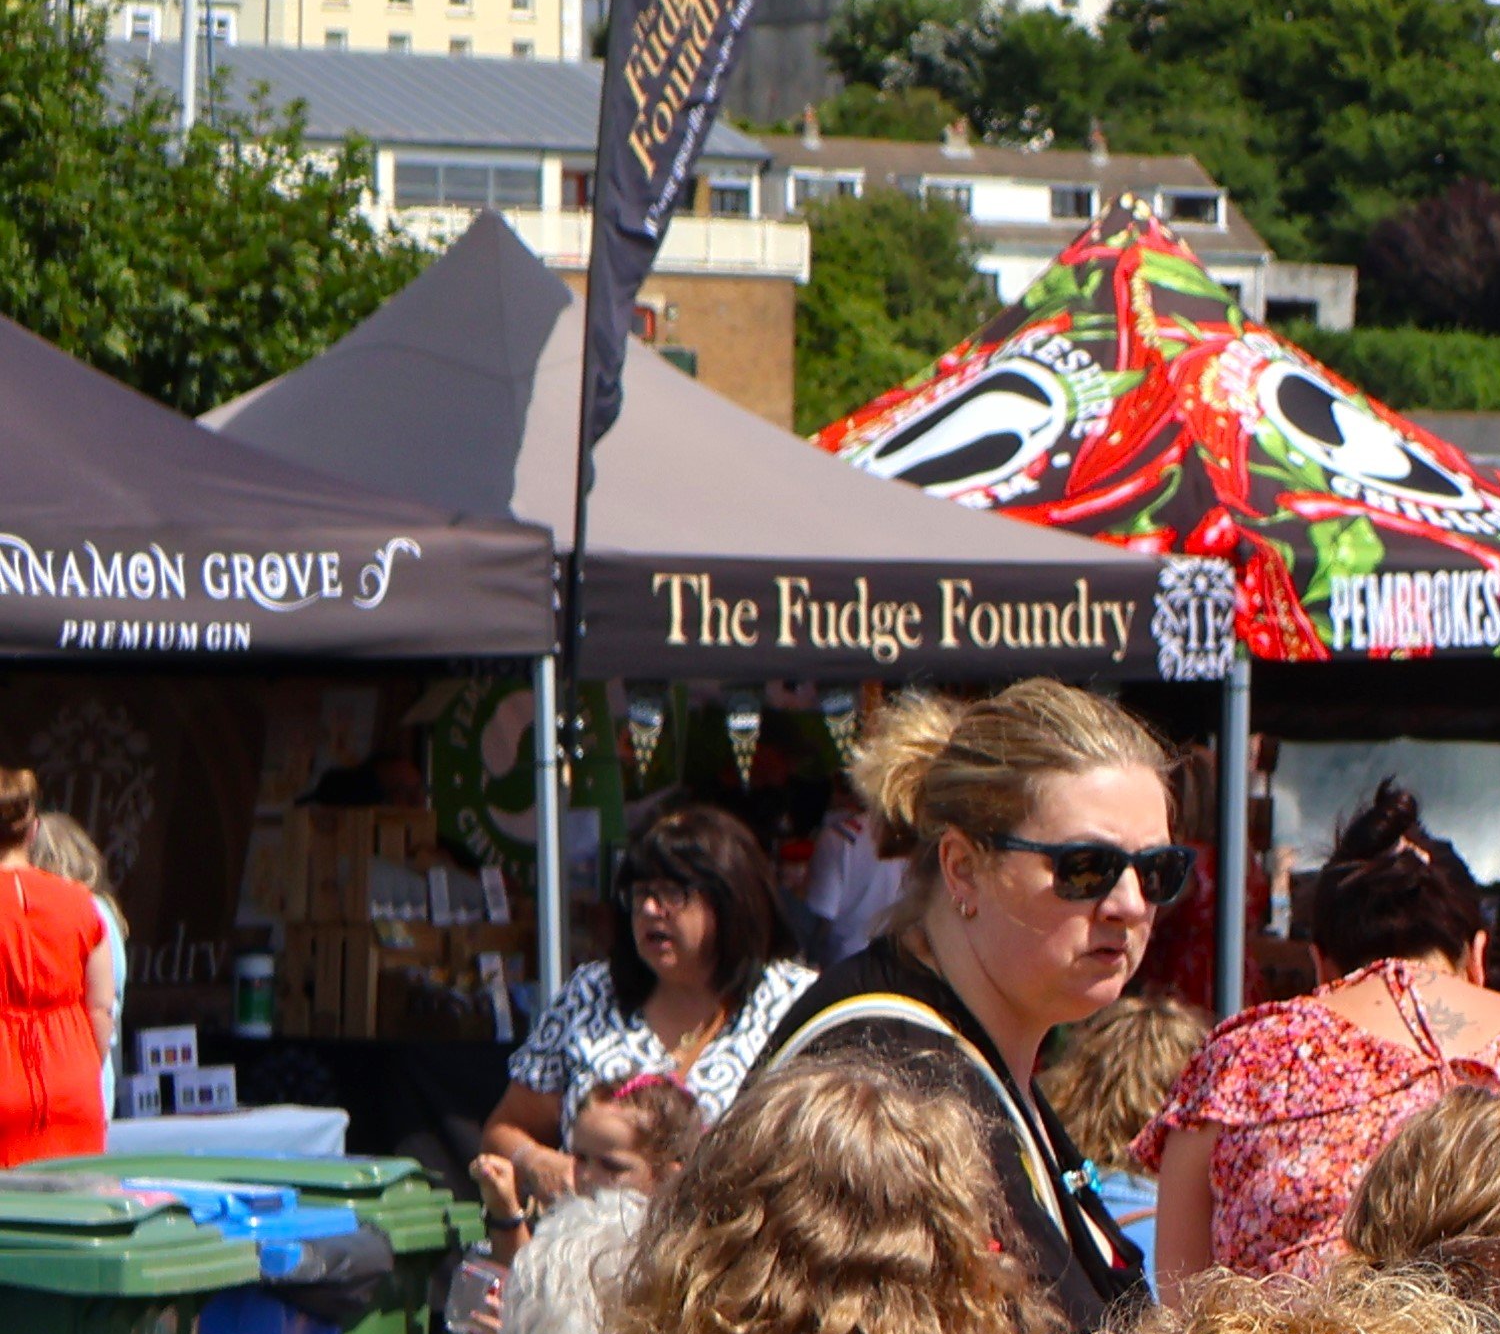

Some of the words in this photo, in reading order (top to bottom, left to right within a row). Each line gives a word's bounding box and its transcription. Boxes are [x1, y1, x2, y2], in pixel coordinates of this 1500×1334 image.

[201, 550, 343, 613] GROVE
[58, 619, 198, 651] PREMIUM
[205, 621, 252, 652] GIN
[652, 573, 759, 645] The
[774, 576, 923, 664] Fudge
[938, 577, 1137, 662] Foundry
